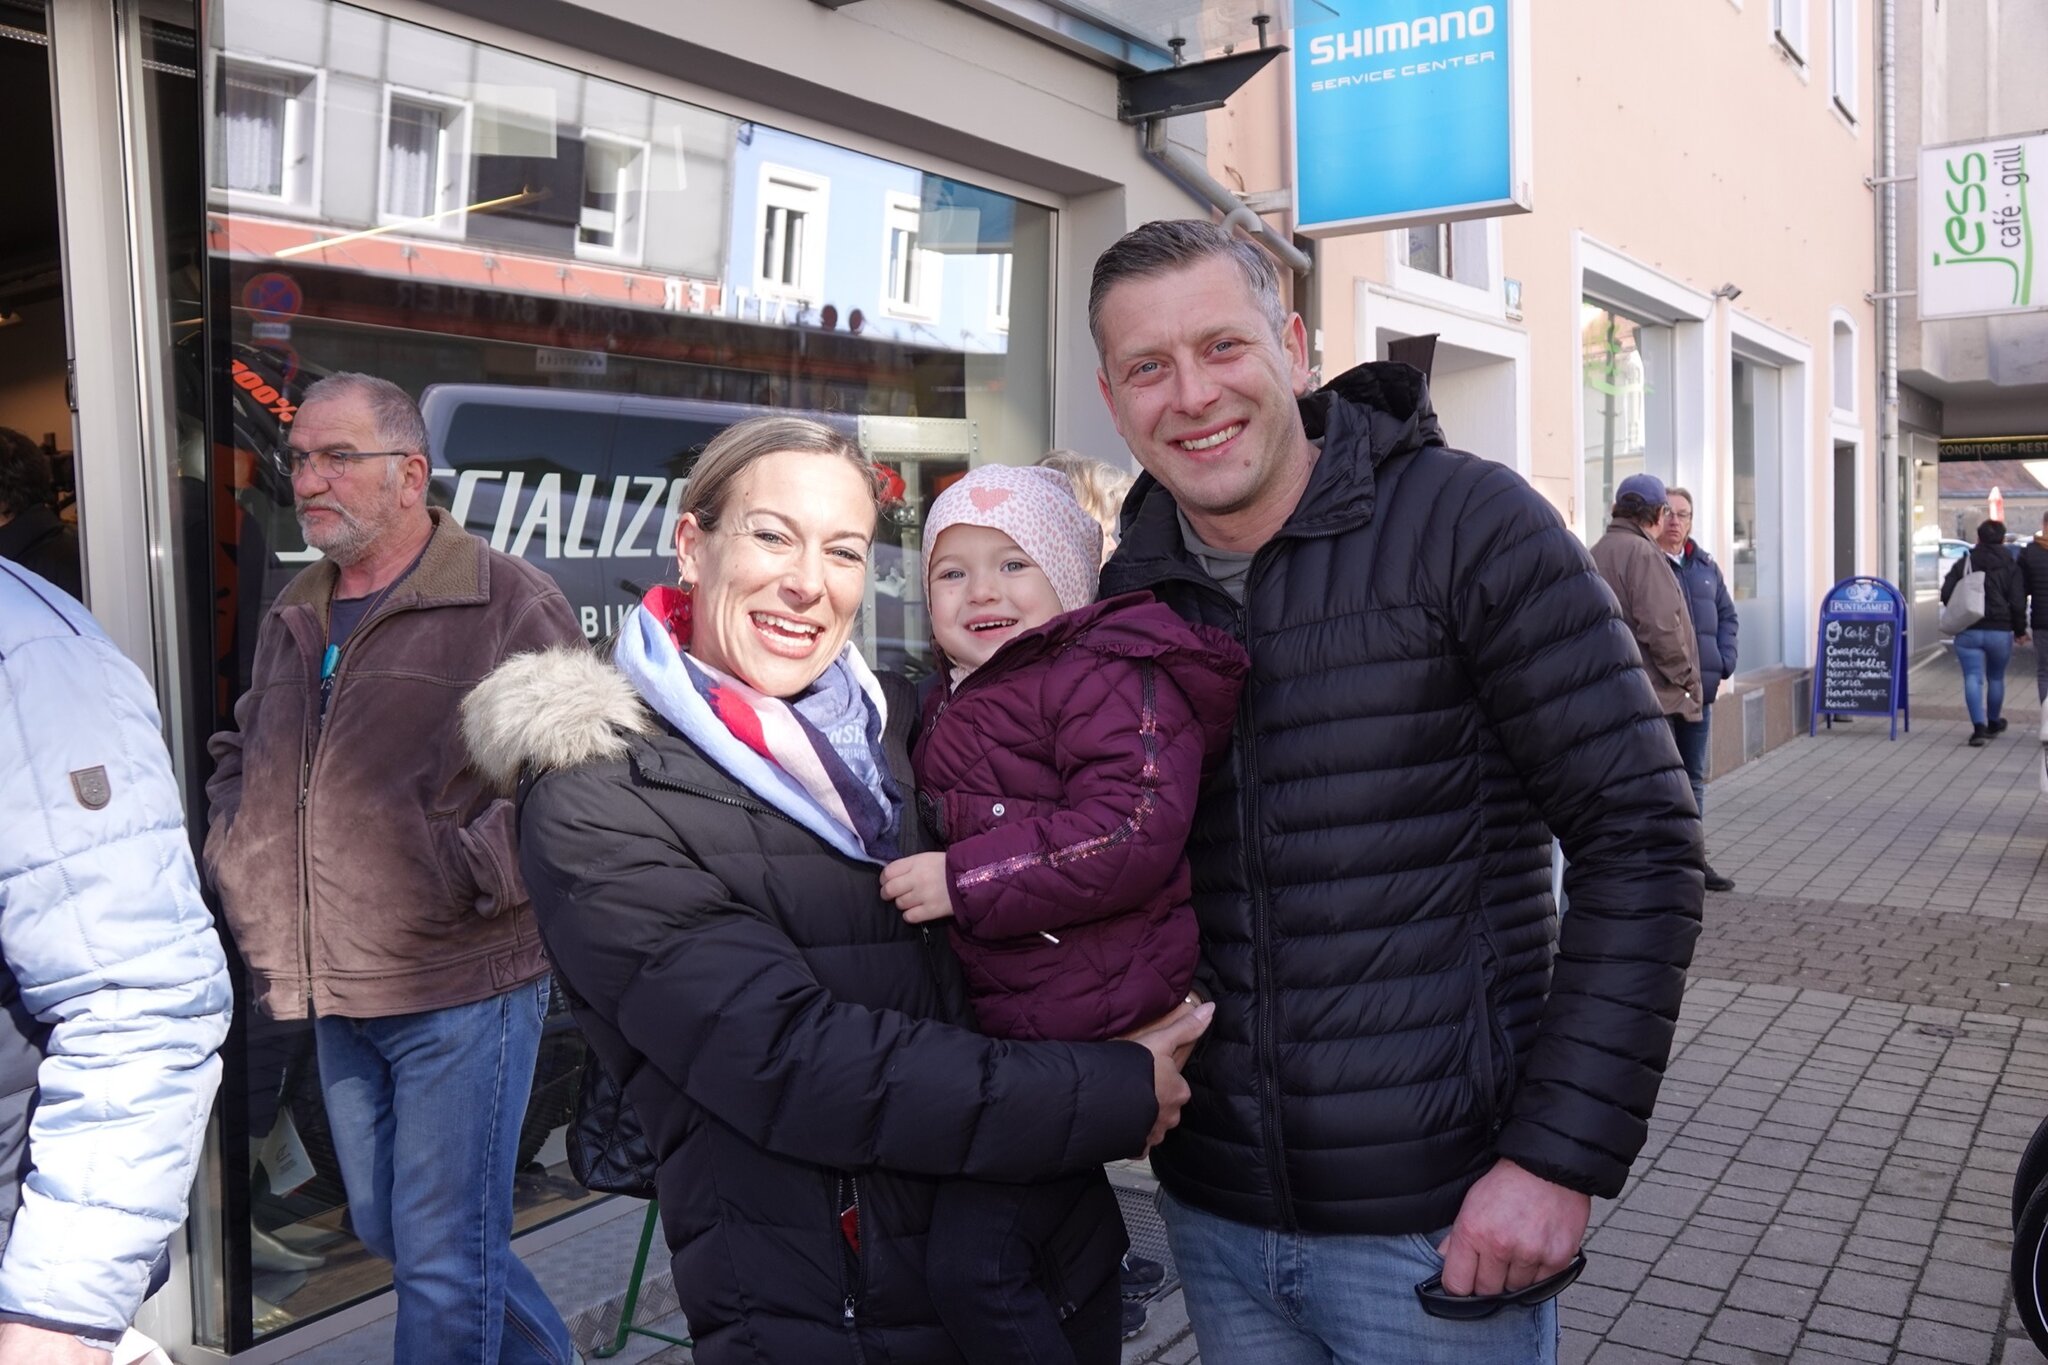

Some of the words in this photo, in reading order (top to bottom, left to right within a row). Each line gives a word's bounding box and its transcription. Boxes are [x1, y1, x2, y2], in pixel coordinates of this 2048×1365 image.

[1310, 5, 1495, 65] SHIMANO
[1311, 68, 1396, 92] SERVICE
[1401, 51, 1495, 76] CENTER
[1993, 145, 2029, 187] grill
[1933, 153, 2019, 305] jess
[1993, 206, 2022, 248] café
[1834, 602, 1890, 611] PUNTIGAMER
